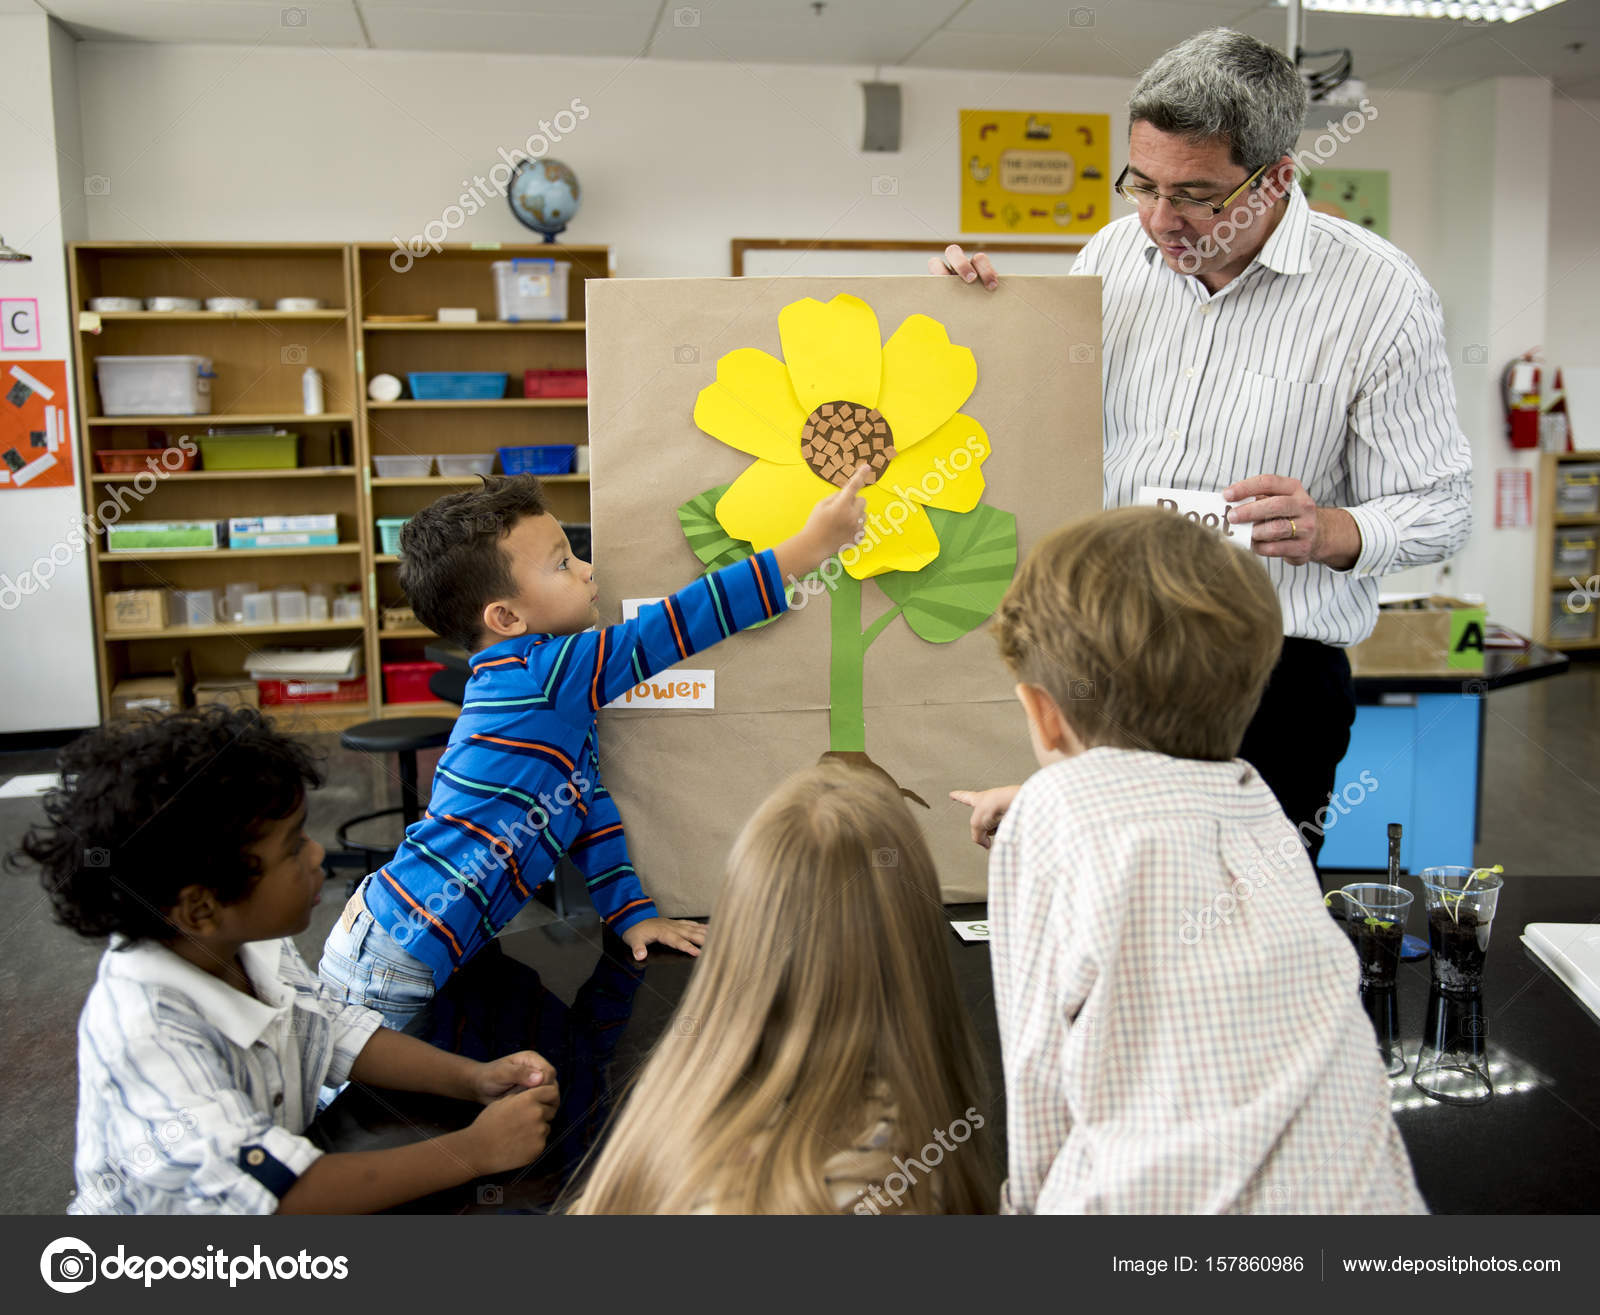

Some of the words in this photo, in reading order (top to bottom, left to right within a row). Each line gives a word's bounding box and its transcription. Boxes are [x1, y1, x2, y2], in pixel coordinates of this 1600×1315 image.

[11, 311, 30, 335] C
[1454, 621, 1484, 654] A
[610, 681, 707, 703] ower
